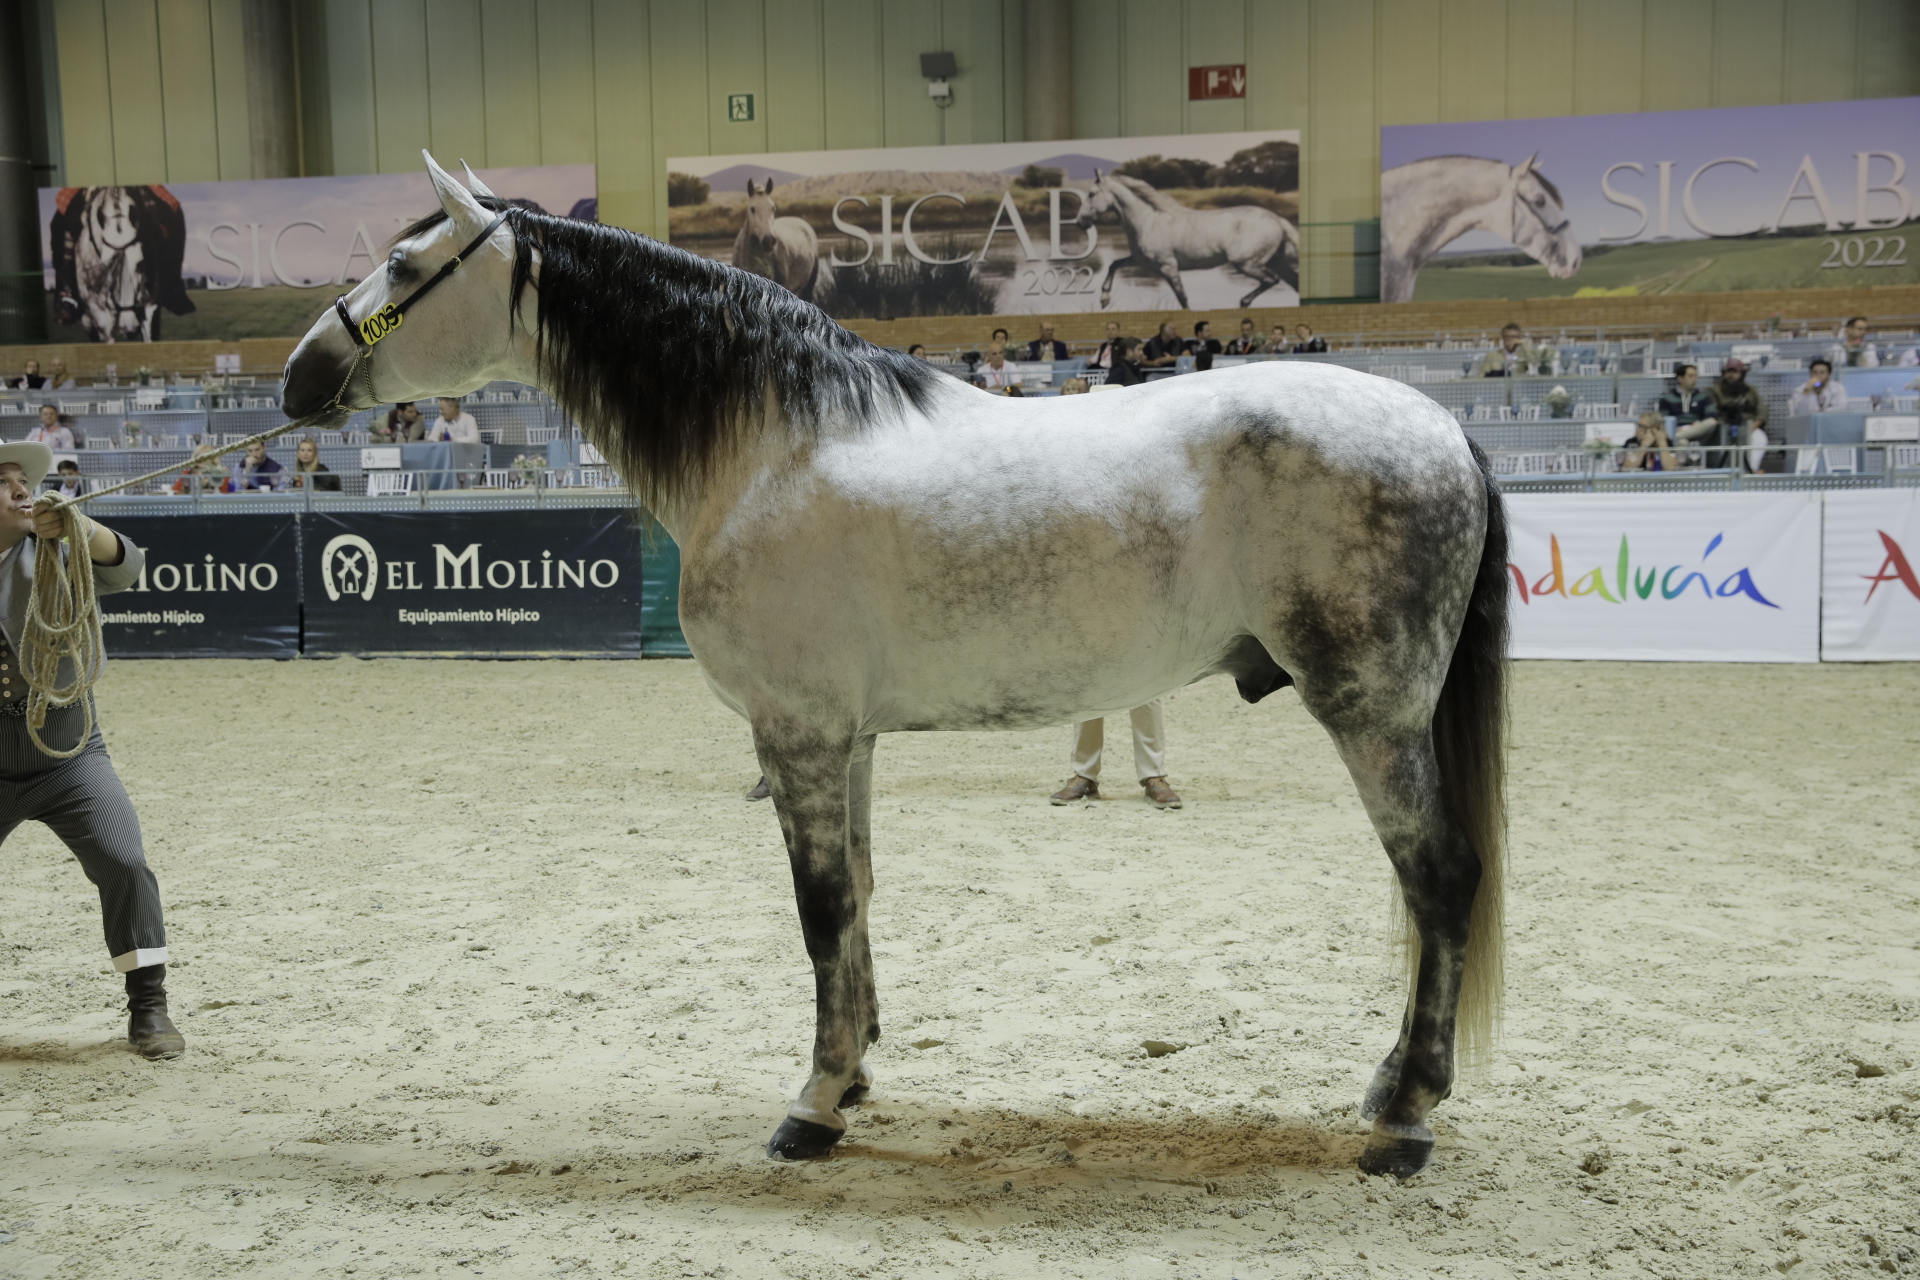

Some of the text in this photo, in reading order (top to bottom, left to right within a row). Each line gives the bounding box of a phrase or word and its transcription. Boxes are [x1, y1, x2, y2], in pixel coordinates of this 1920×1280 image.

[1598, 152, 1913, 242] SICAB
[830, 188, 1098, 267] SICAB
[206, 217, 419, 291] SICA
[1820, 235, 1907, 269] 2022
[1022, 265, 1096, 296] 2022
[385, 561, 423, 589] EL
[100, 610, 205, 626] pamiento Hípico
[398, 607, 541, 625] Equipamiento Hípico
